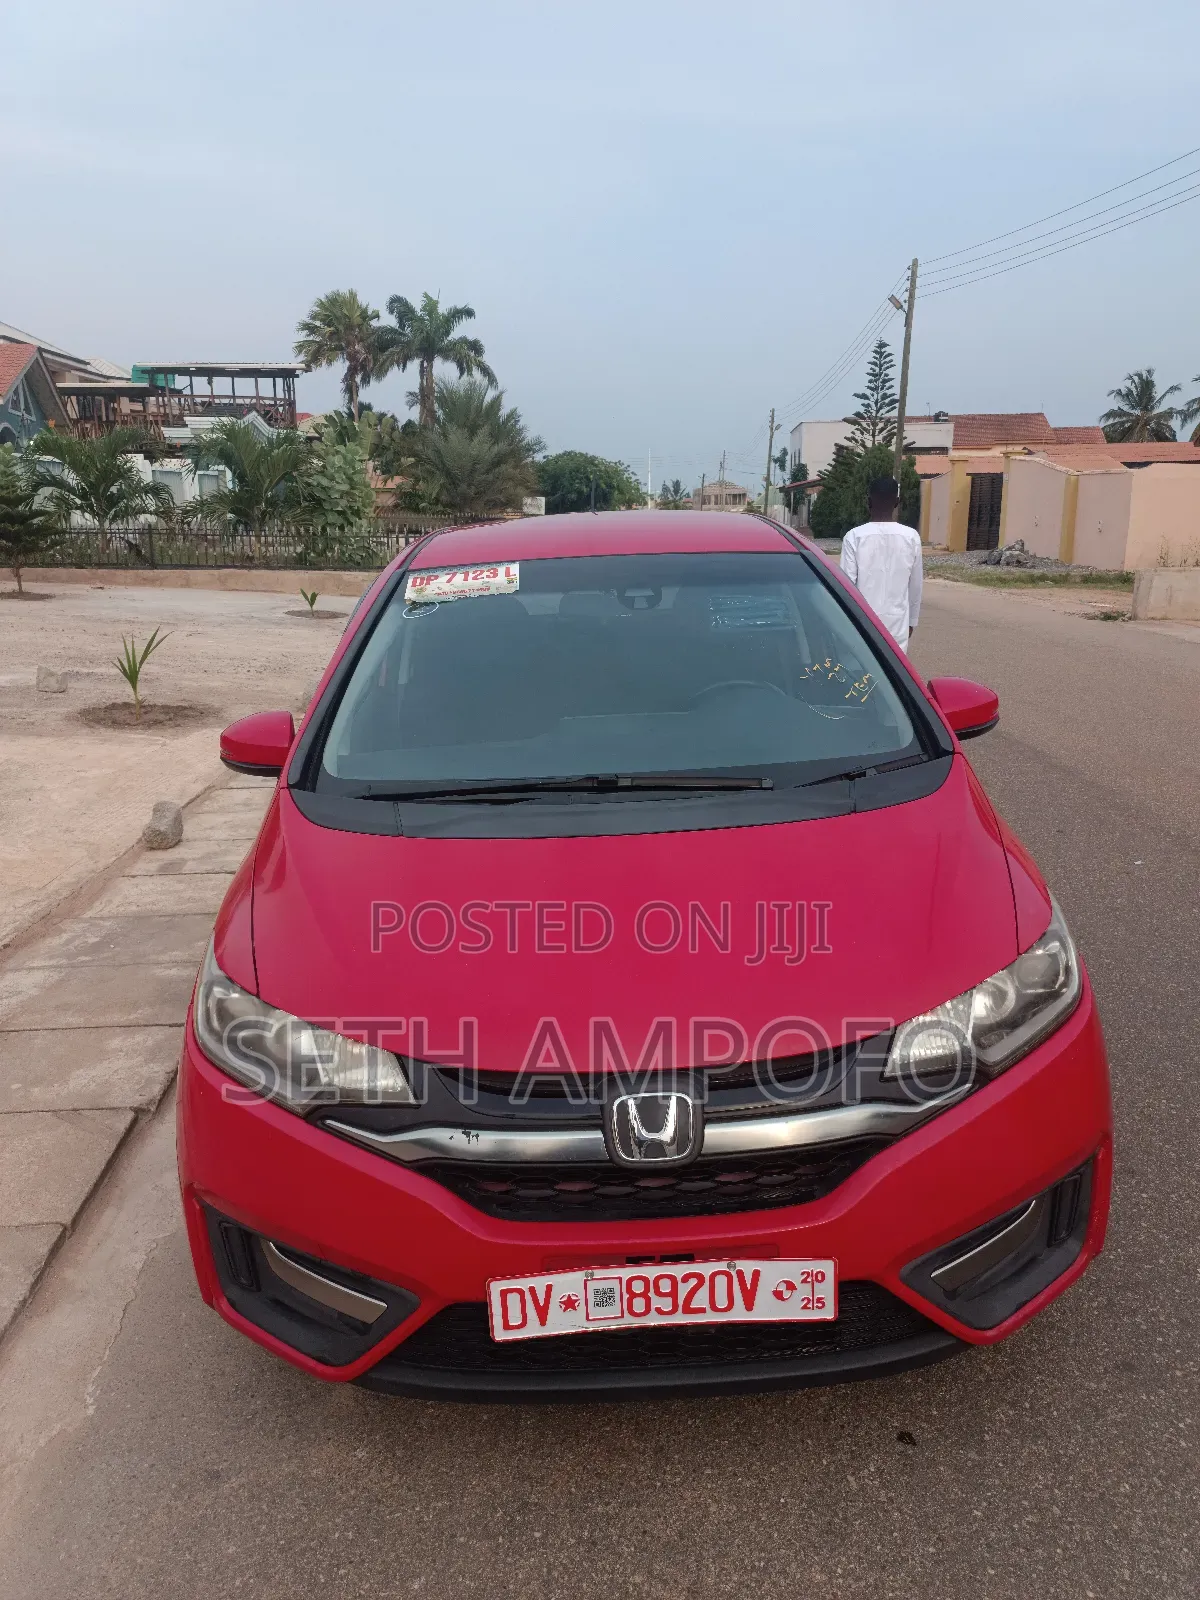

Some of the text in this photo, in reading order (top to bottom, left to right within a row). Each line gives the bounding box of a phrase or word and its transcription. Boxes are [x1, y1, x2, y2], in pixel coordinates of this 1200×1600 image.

[410, 575, 439, 588] DP
[445, 568, 498, 583] 7123
[504, 566, 516, 577] L
[800, 1269, 826, 1284] 20
[500, 1268, 761, 1331] DV 8920V
[800, 1295, 826, 1310] 25
